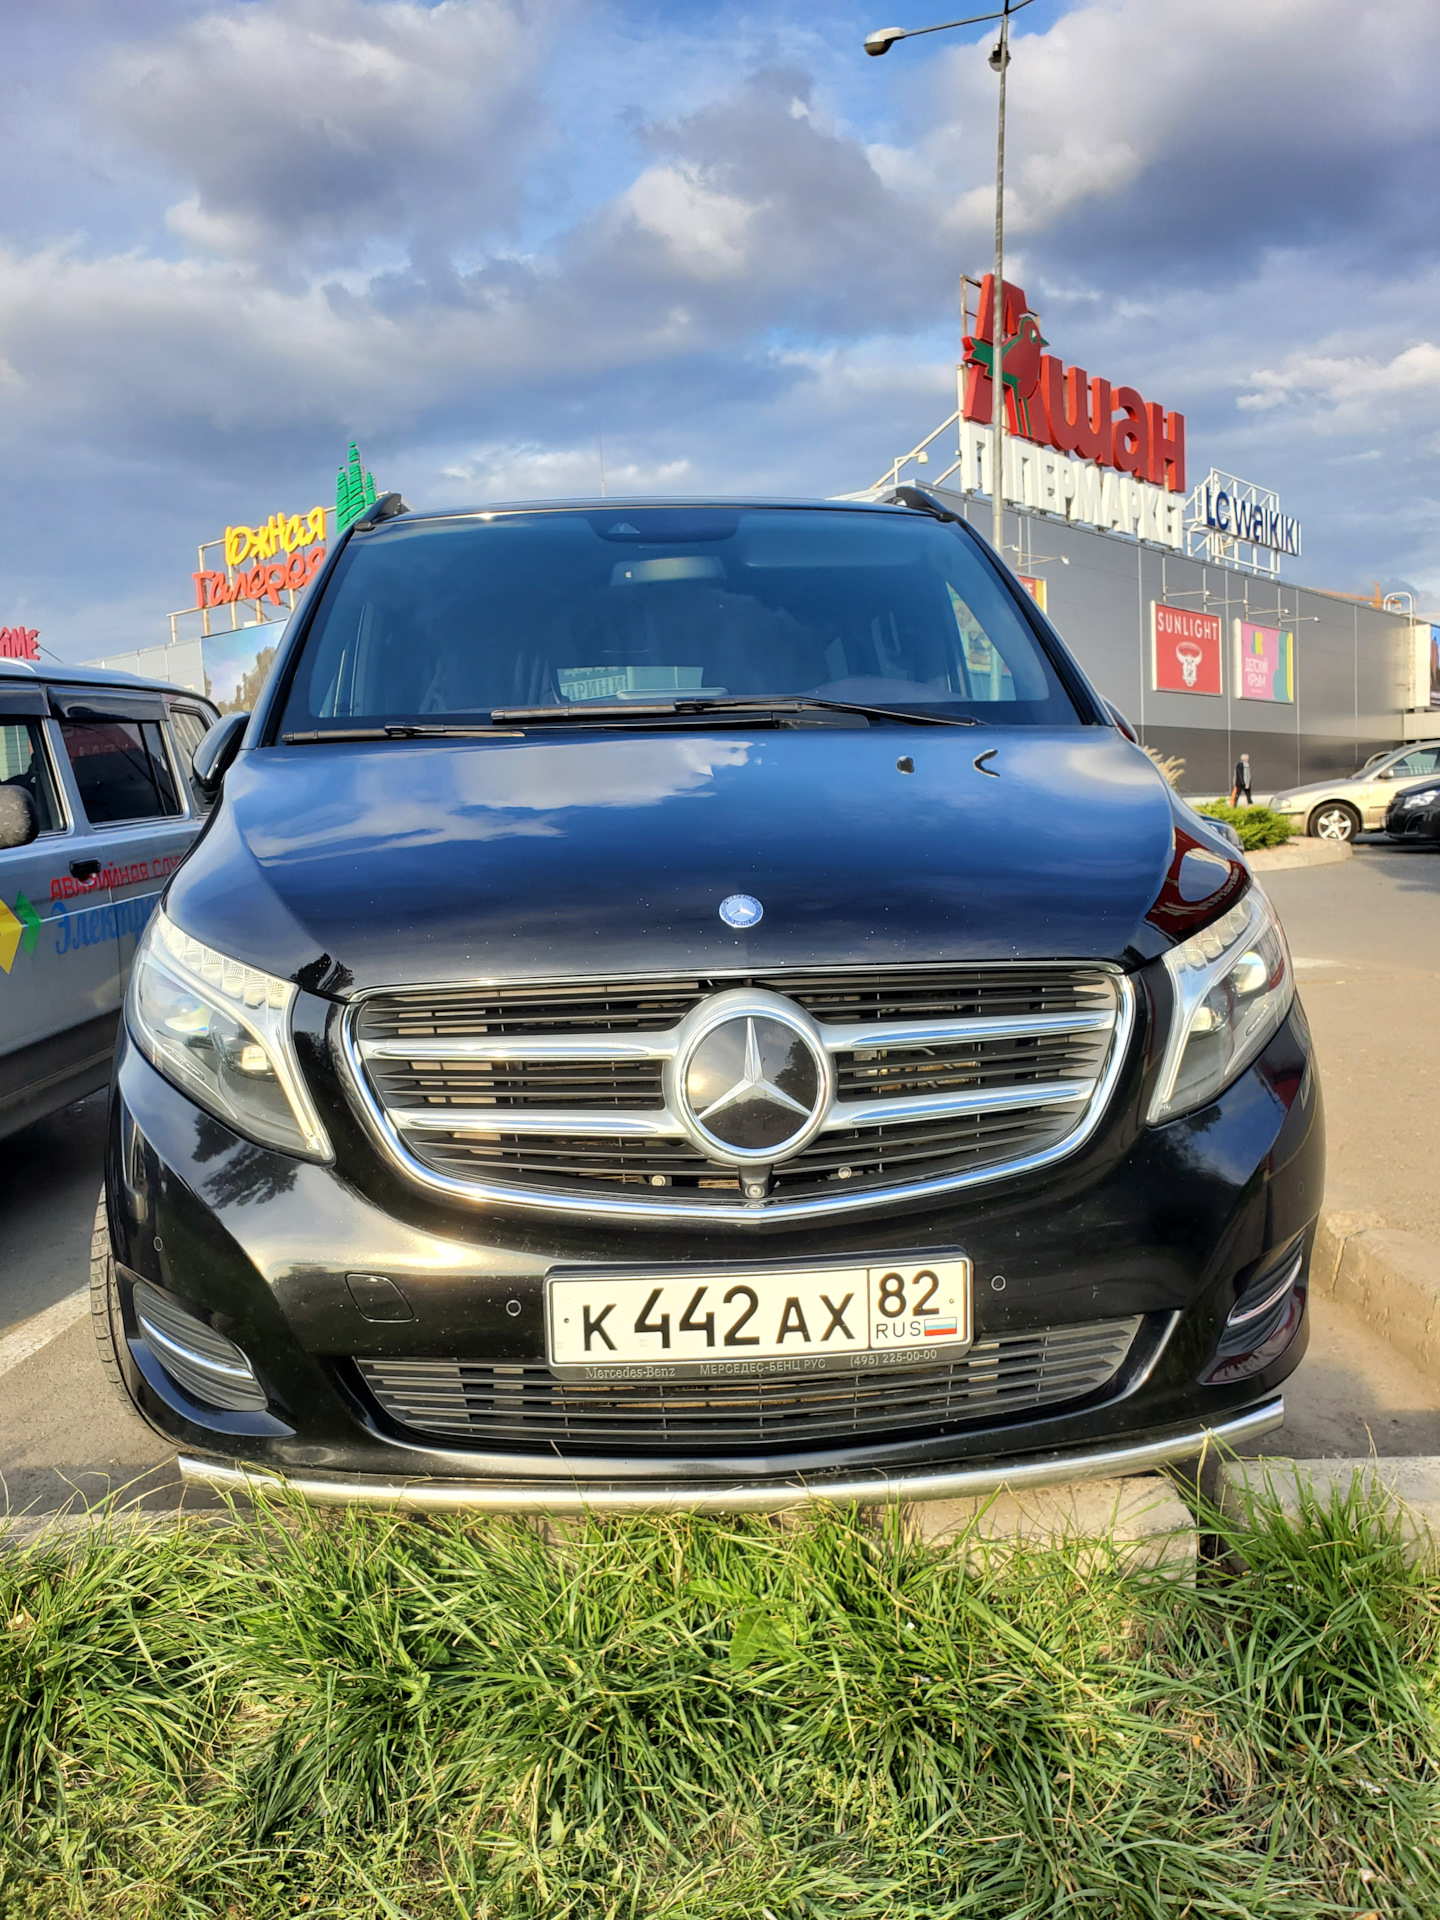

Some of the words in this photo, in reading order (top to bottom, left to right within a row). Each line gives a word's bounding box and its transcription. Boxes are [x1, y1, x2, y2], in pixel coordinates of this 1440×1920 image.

[1202, 485, 1229, 531] LC
[192, 547, 326, 608] Галерея
[1157, 611, 1218, 640] SUNLIGHT
[878, 1269, 940, 1318] 82
[876, 1321, 921, 1339] RUS
[585, 1366, 676, 1379] Mercedes-Benz
[700, 1361, 801, 1375] МЕРСЕДЕС-БЕНЦ
[804, 1358, 826, 1369] РУС
[850, 1353, 879, 1367] (495)
[882, 1349, 937, 1364] 225-00-00
